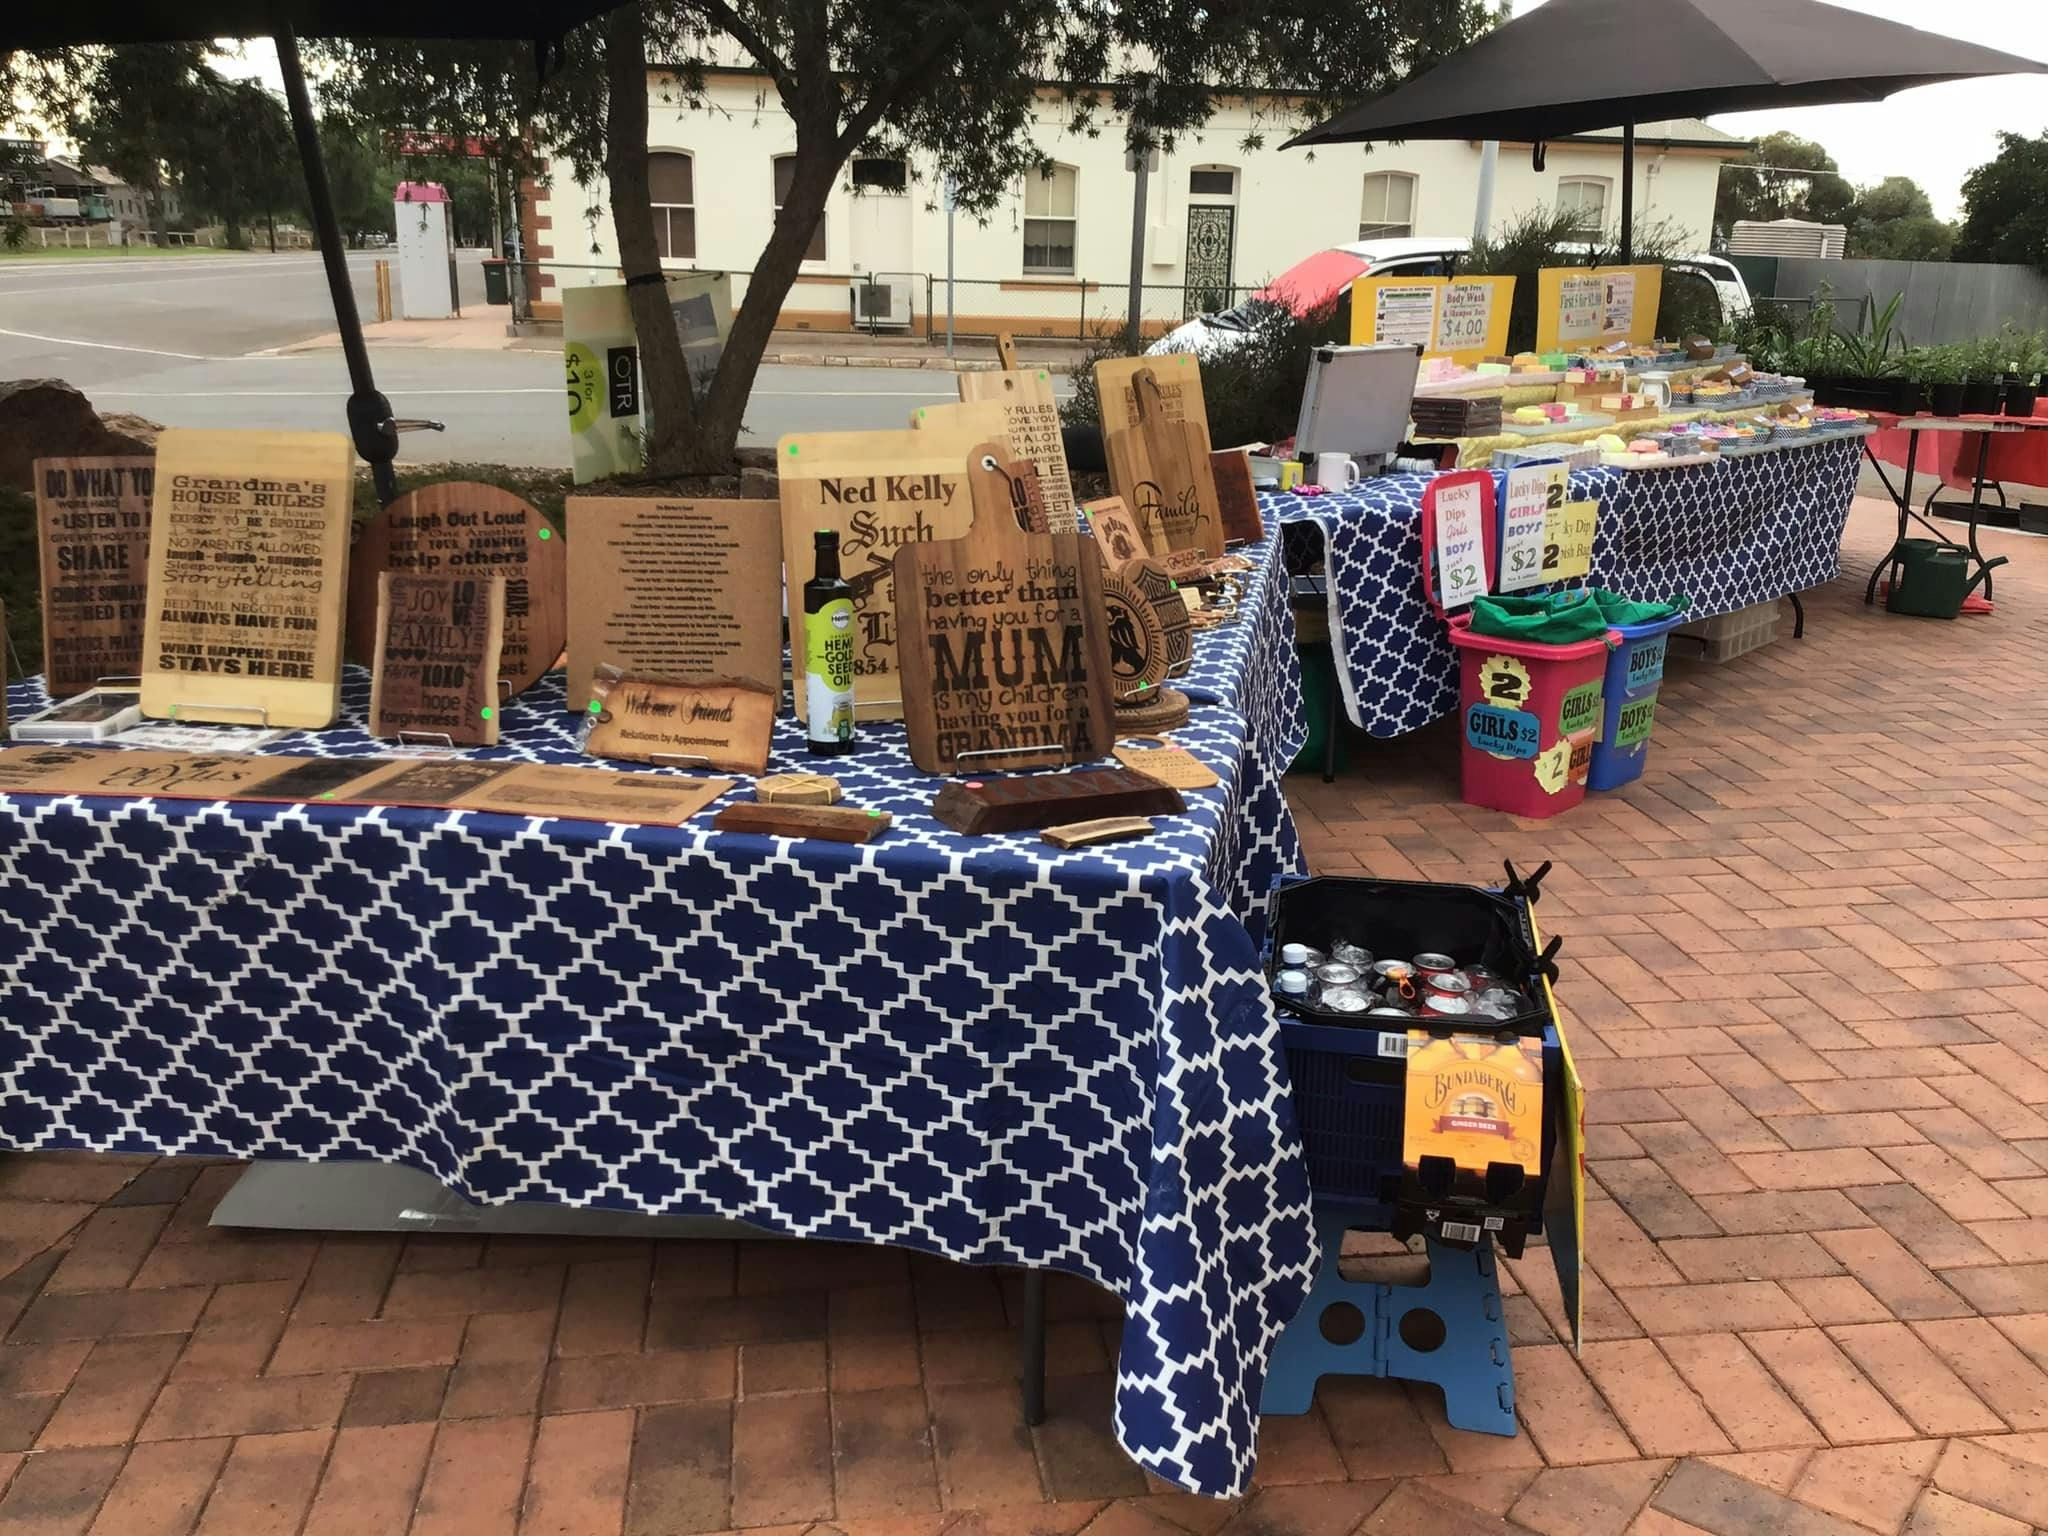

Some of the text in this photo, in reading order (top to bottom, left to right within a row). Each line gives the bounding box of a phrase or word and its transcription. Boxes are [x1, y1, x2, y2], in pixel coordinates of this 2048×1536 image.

[1446, 292, 1486, 304] Body Wash
[1445, 319, 1483, 337] $4.00
[614, 354, 632, 411] OTR
[1009, 416, 1031, 425] OVE
[1015, 404, 1054, 415] RULES
[72, 467, 125, 497] WHAT
[172, 475, 327, 495] Grandma's
[819, 474, 957, 506] Ned Kelly
[171, 489, 326, 508] HOUSE RULES
[1133, 481, 1210, 534] Family
[1441, 488, 1471, 503] Lucky
[1547, 483, 1563, 509] 2
[63, 511, 141, 529] LISTEN TO
[247, 517, 263, 528] BE
[388, 509, 527, 532] Laugh Out Loud
[1445, 509, 1466, 522] Dips
[1509, 502, 1545, 519] GIRLS
[842, 509, 934, 556] Such
[1508, 522, 1543, 538] BOYS
[57, 544, 130, 571] SHARE
[169, 537, 321, 556] NO PARENTS ALLOWED
[1446, 541, 1474, 556] BOYS
[1542, 544, 1560, 570] 2
[165, 561, 323, 578] Sleepovers Welcome
[388, 550, 529, 569] help others
[499, 566, 529, 577] YOU
[1511, 547, 1537, 572] $2
[162, 569, 323, 593] Storytelling
[922, 558, 1077, 591] the only thing
[1450, 564, 1478, 591] $2
[407, 590, 450, 613] JOY
[924, 580, 1080, 609] better than
[161, 610, 231, 626] ALWAYS
[235, 614, 280, 629] HAVE
[284, 617, 319, 631] FUN
[926, 602, 1083, 633] having you for a
[386, 625, 474, 650] FAMILY
[161, 642, 204, 656] WHAT
[207, 645, 275, 660] HAPPENS
[278, 649, 316, 663] HERE
[928, 624, 1088, 692] MUM
[1630, 647, 1657, 672] BOYS
[160, 655, 315, 679] STAYS HERE
[853, 658, 889, 676] 854
[833, 674, 851, 686] OIL
[1490, 672, 1522, 701] 2
[421, 692, 461, 714] hope
[622, 690, 735, 725] Welcome Friends
[934, 683, 1089, 713] is my children
[1562, 692, 1593, 720] GIRLS
[936, 704, 1090, 732] having you for a
[1470, 712, 1537, 744] GIRLS $2
[1619, 704, 1648, 731] BOYS
[620, 729, 730, 748] Relations by Appointment
[936, 722, 1095, 764] GRANDMA
[1477, 736, 1527, 755] Lucky Dips
[1551, 751, 1564, 780] 2
[1424, 1068, 1527, 1117] BUNDABERG
[1451, 1119, 1497, 1132] GINGER BEER
